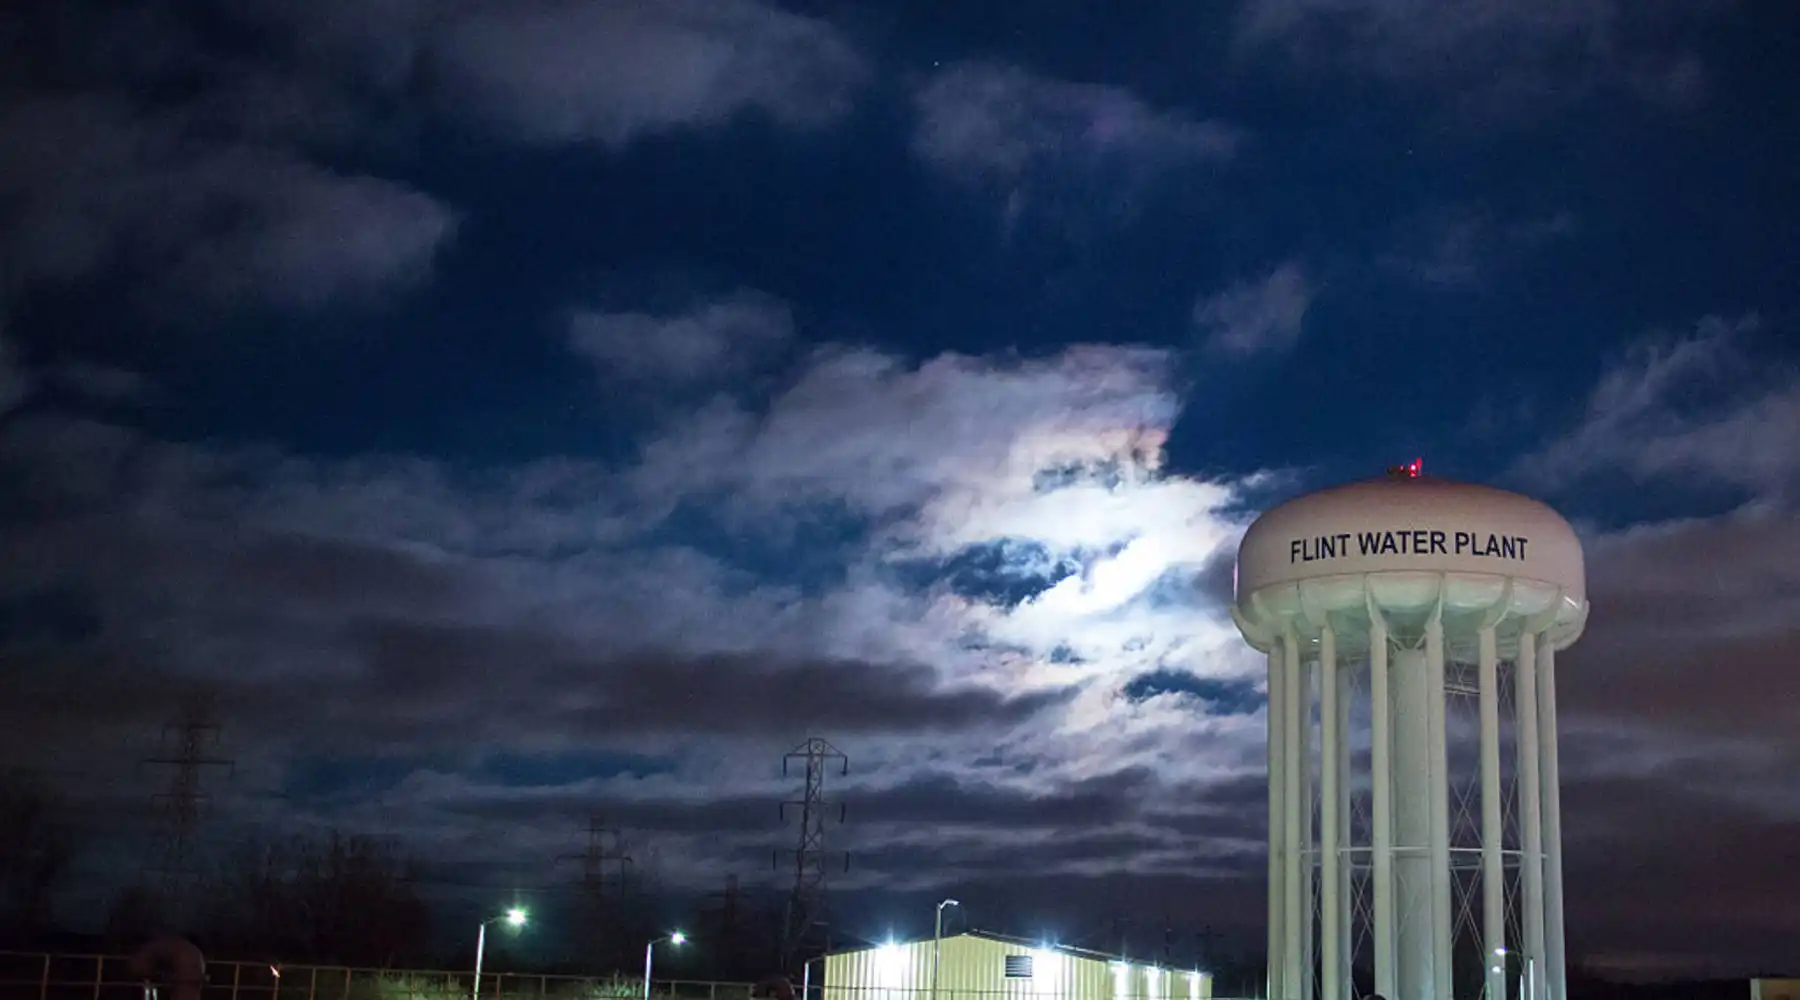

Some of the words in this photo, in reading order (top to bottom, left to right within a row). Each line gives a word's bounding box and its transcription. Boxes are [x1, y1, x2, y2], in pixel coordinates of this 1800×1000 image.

[1290, 533, 1351, 564] FLINT
[1357, 530, 1447, 556] WATER
[1454, 531, 1529, 561] PLANT
